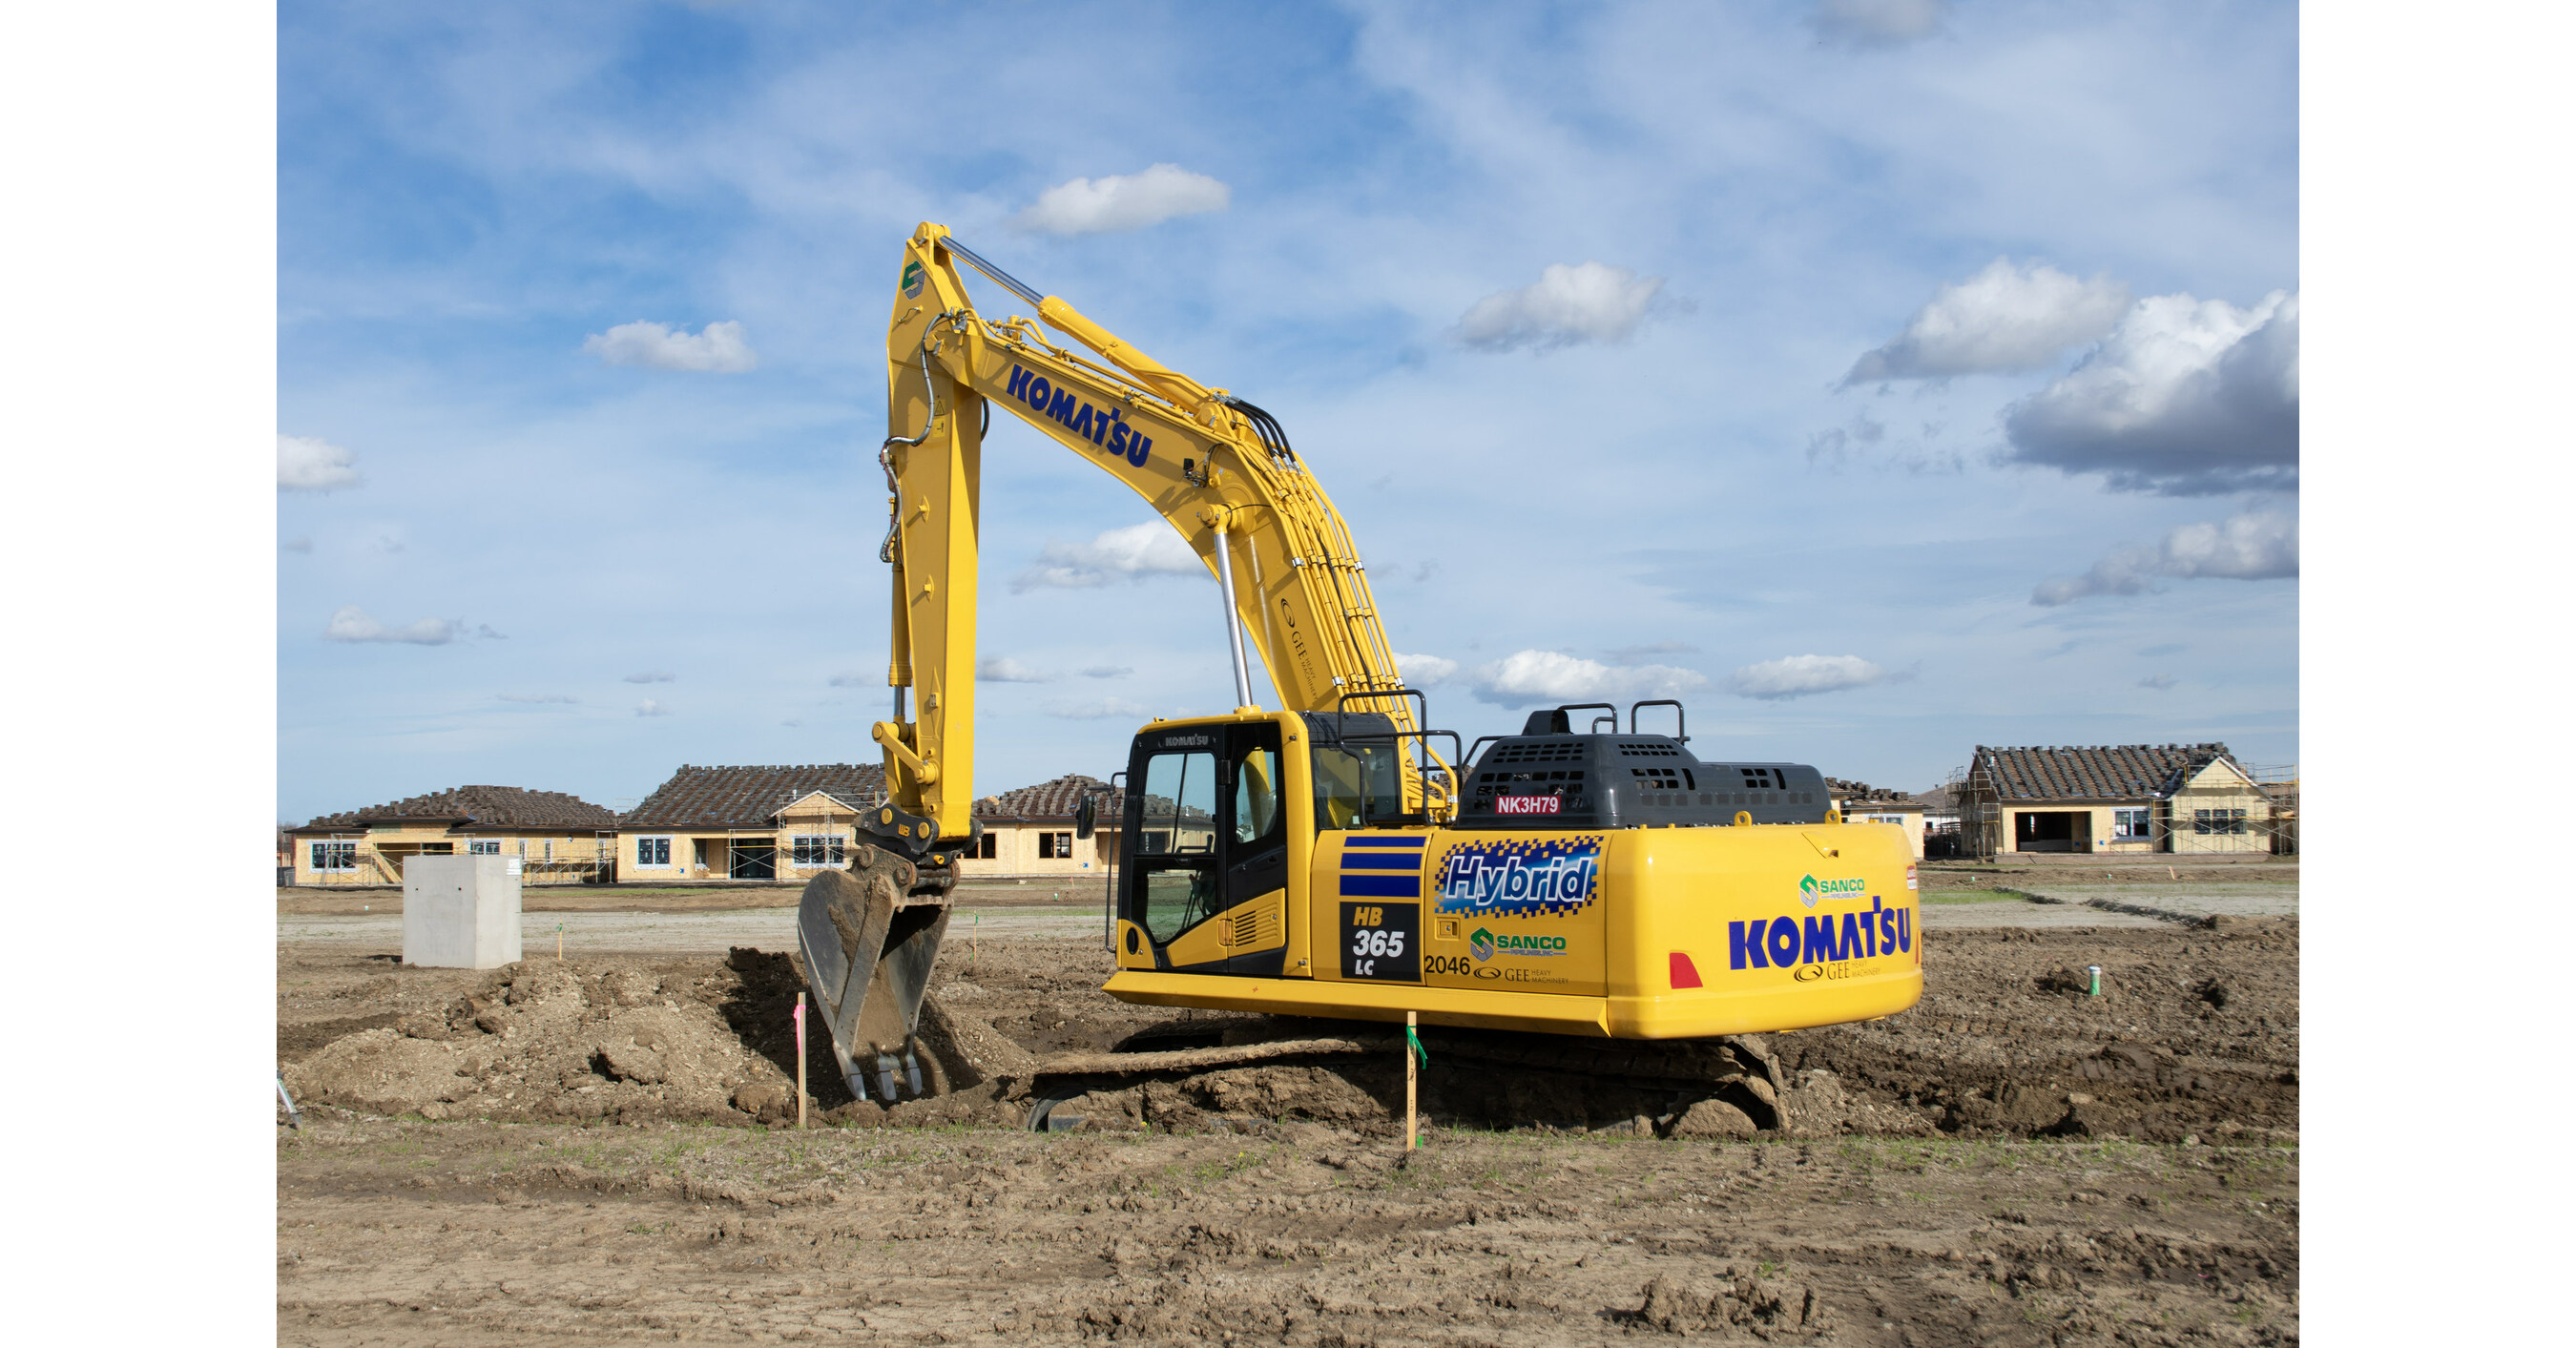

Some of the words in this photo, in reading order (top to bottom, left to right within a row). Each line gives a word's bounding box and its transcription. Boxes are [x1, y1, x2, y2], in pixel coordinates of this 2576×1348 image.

[1007, 363, 1153, 467] KOMATSU
[1292, 631, 1308, 660] GEE
[1305, 657, 1317, 679] HEAVY
[1301, 661, 1318, 700] MACHINERY
[1165, 733, 1209, 747] KOMATSU
[1498, 797, 1559, 813] NK3H79
[1445, 856, 1592, 906] Hybrid
[1819, 879, 1865, 893] SANCO
[1353, 906, 1383, 926] HB
[1496, 935, 1567, 950] SANCO
[1728, 896, 1911, 970] KOMATSU
[1352, 929, 1404, 958] 365
[1355, 959, 1374, 976] LC
[1424, 955, 1470, 974] 2046
[1827, 962, 1849, 980] GEE
[1505, 968, 1529, 982] GEE
